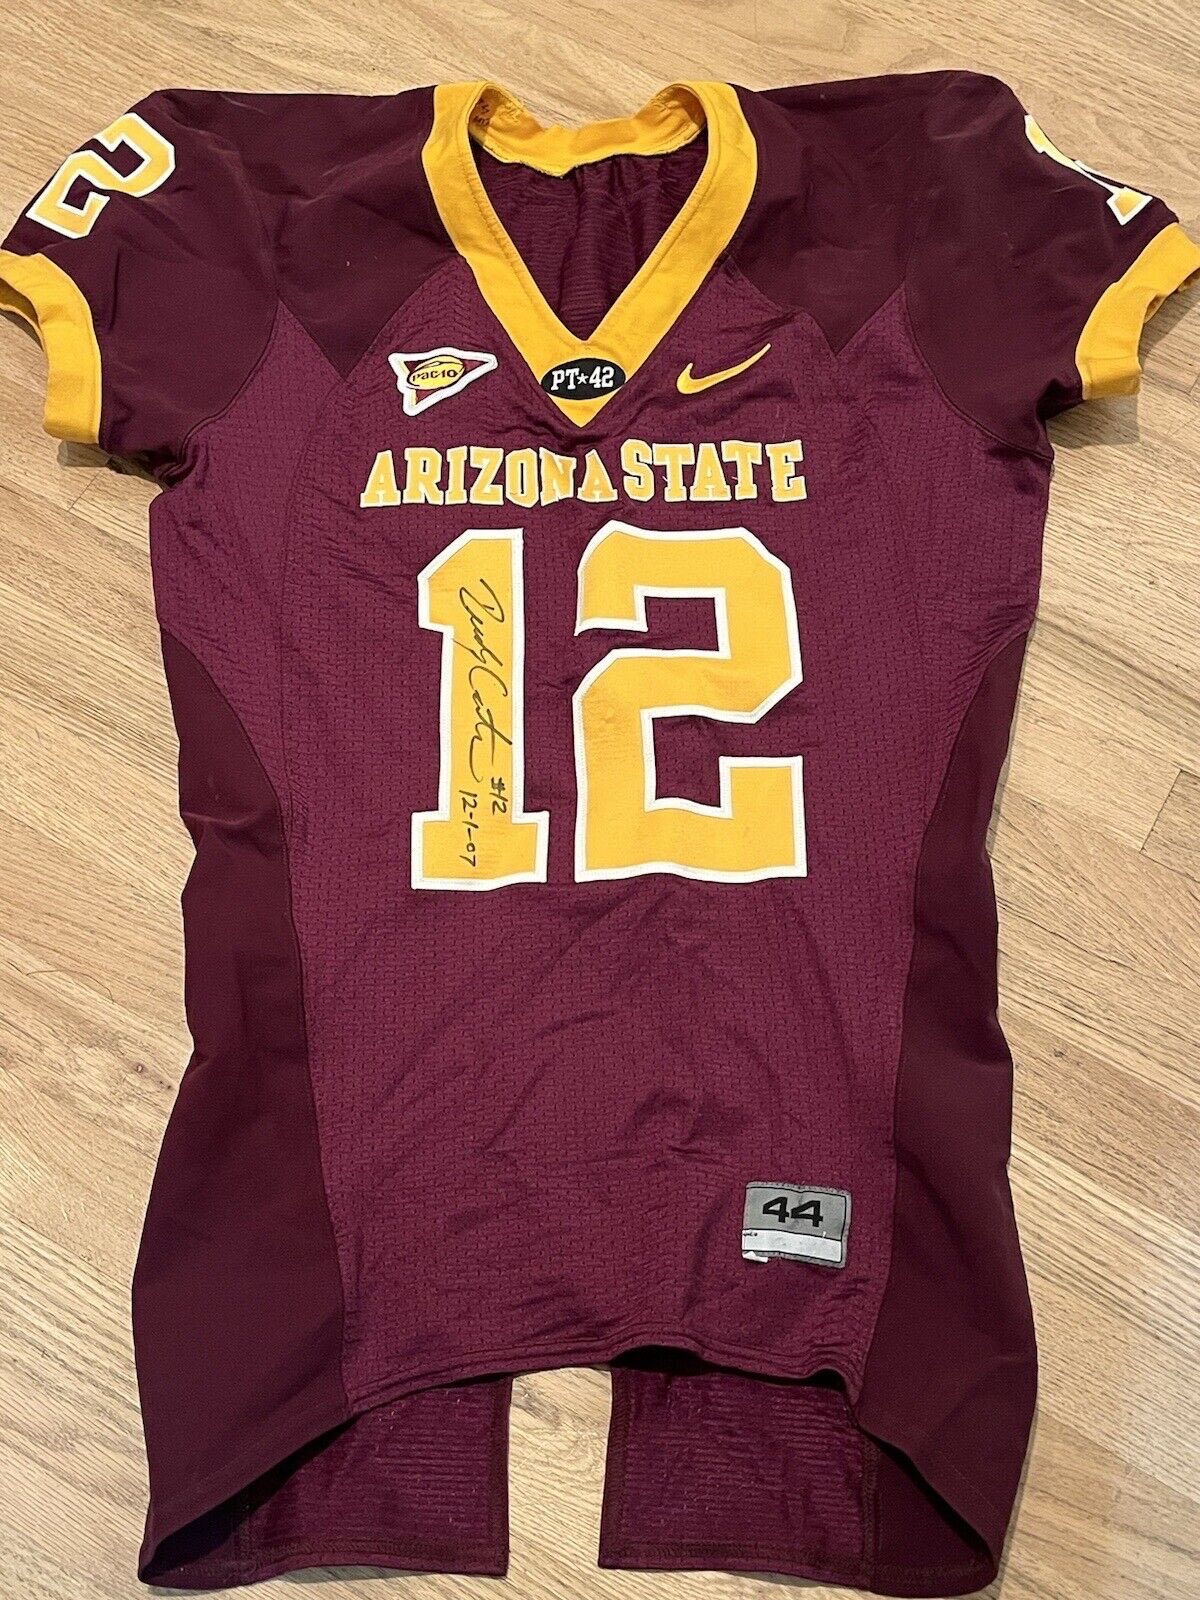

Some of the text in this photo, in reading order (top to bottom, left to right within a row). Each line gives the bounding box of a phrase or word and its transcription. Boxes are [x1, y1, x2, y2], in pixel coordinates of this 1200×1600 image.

[26, 112, 176, 239] 2
[359, 438, 808, 508] ARIZONA STATE
[411, 520, 808, 892] 12
[458, 789, 478, 868] 12-1-07
[762, 1196, 824, 1228] 44
